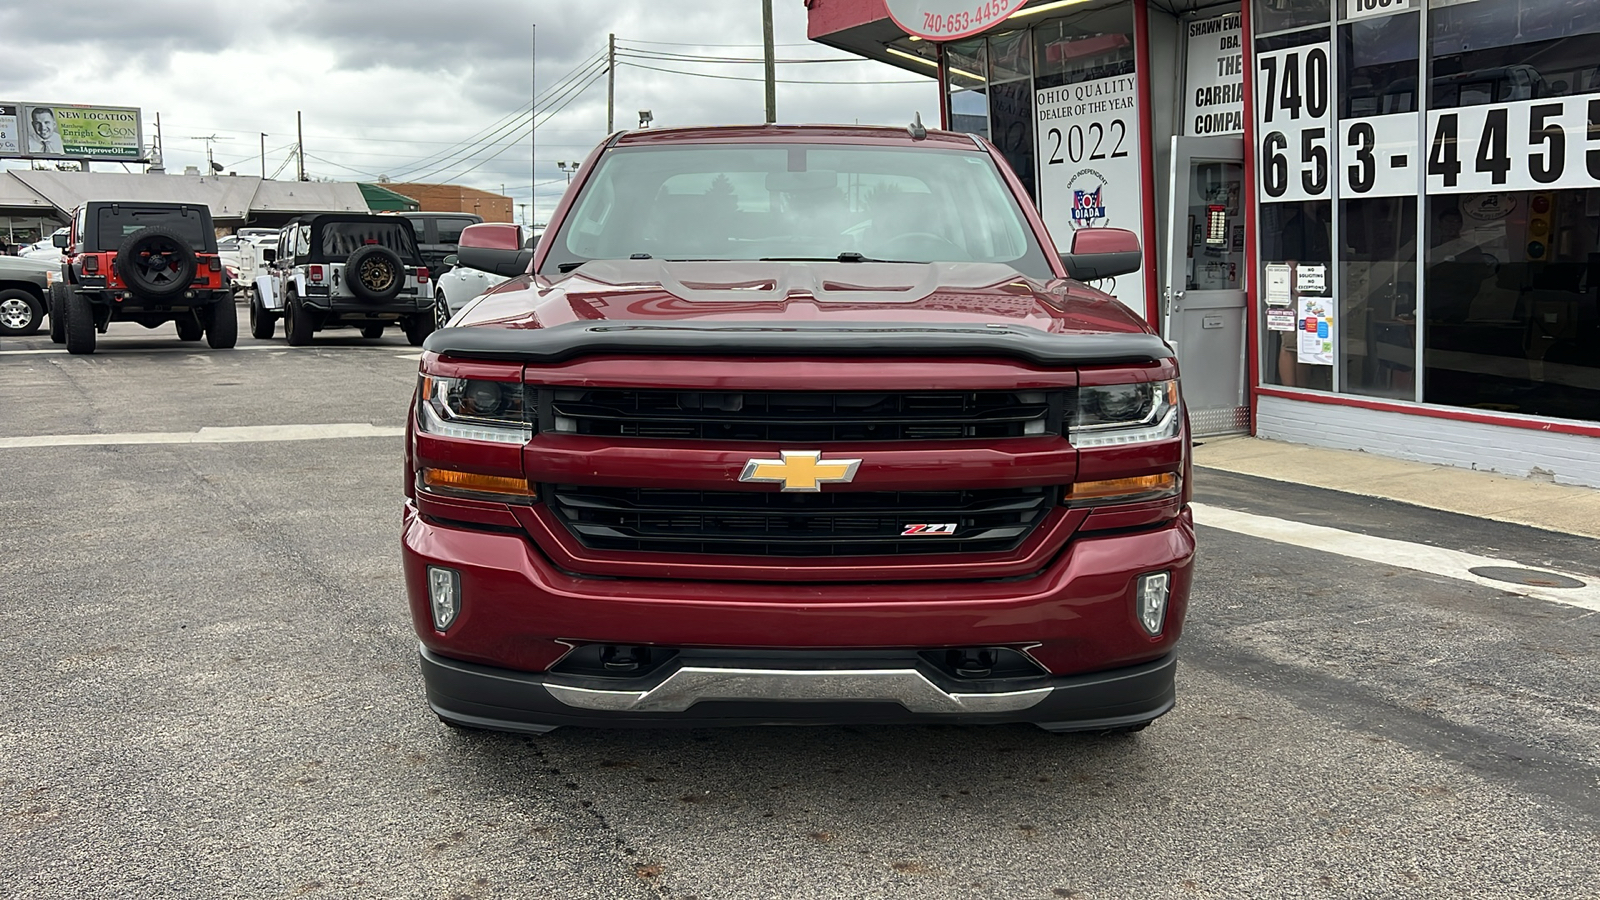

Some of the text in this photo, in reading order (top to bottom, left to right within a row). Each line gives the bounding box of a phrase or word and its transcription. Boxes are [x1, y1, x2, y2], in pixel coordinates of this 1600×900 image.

[923, 0, 1009, 33] 740-653-4455
[1189, 15, 1242, 37] SHAWN EVA
[1220, 35, 1241, 50] DBA.
[1217, 55, 1242, 77] THE
[1037, 77, 1135, 105] OHIO QUALITY
[1195, 83, 1243, 108] CARRIA
[1260, 47, 1328, 123] 740
[58, 111, 134, 121] NEW LOCATION
[1039, 96, 1134, 121] DEALER OF THE YEAR
[63, 128, 94, 138] Enright
[1194, 111, 1244, 134] COMPA
[65, 146, 137, 155] www.IApproveOH.com
[1047, 119, 1128, 165] 2022
[1066, 168, 1108, 189] OHIO INDEPENDENT
[1075, 207, 1100, 219] OIADA
[901, 523, 957, 536] Z71
